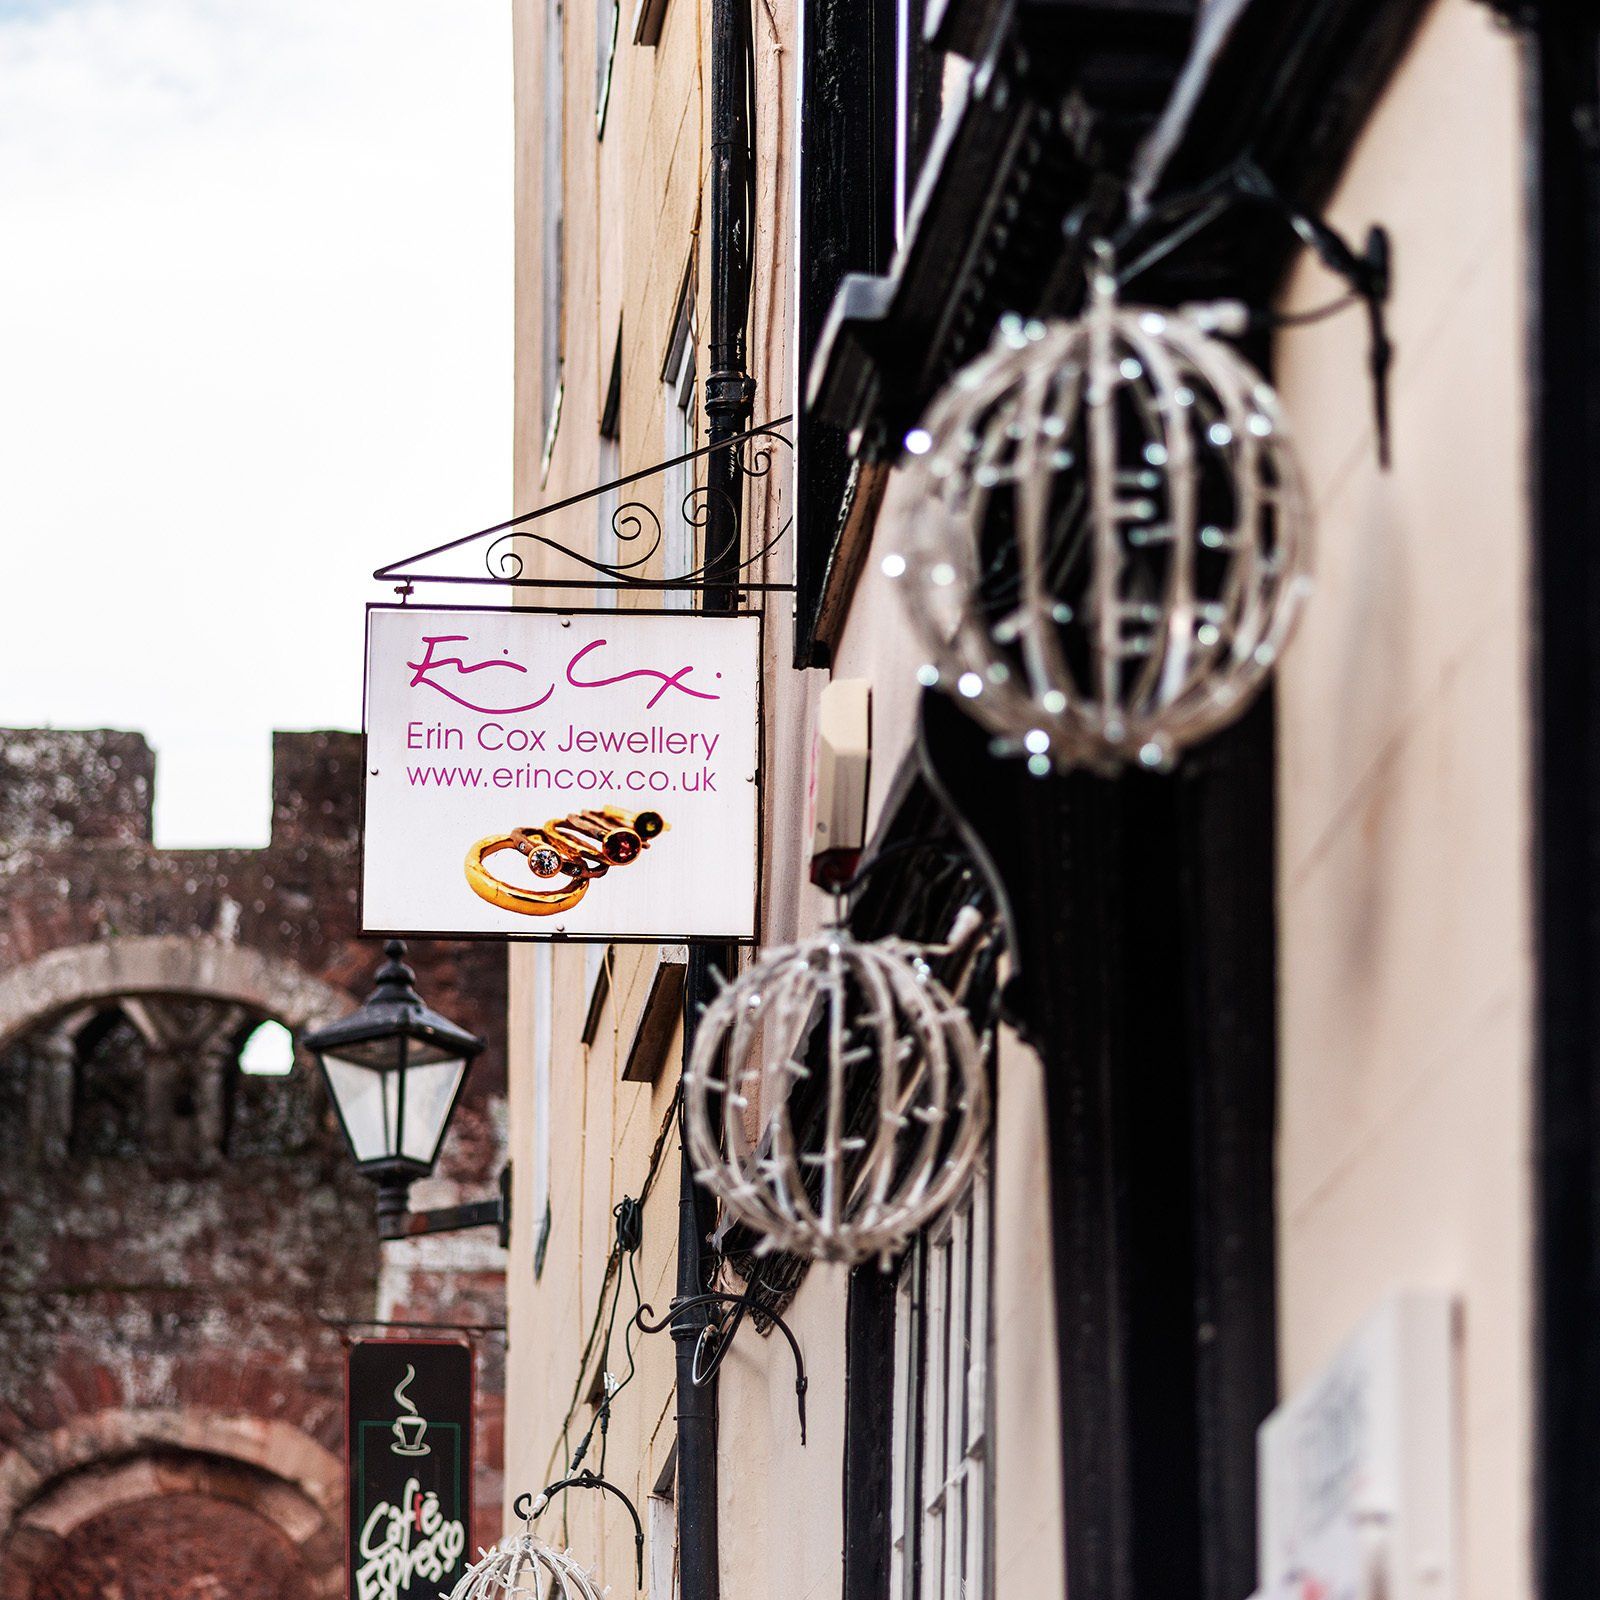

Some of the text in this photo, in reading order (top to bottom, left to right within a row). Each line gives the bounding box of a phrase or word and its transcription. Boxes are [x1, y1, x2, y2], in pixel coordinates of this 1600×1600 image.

[406, 721, 720, 761] Erin Cox Jewellery
[406, 763, 717, 793] www.erincox.co.uk
